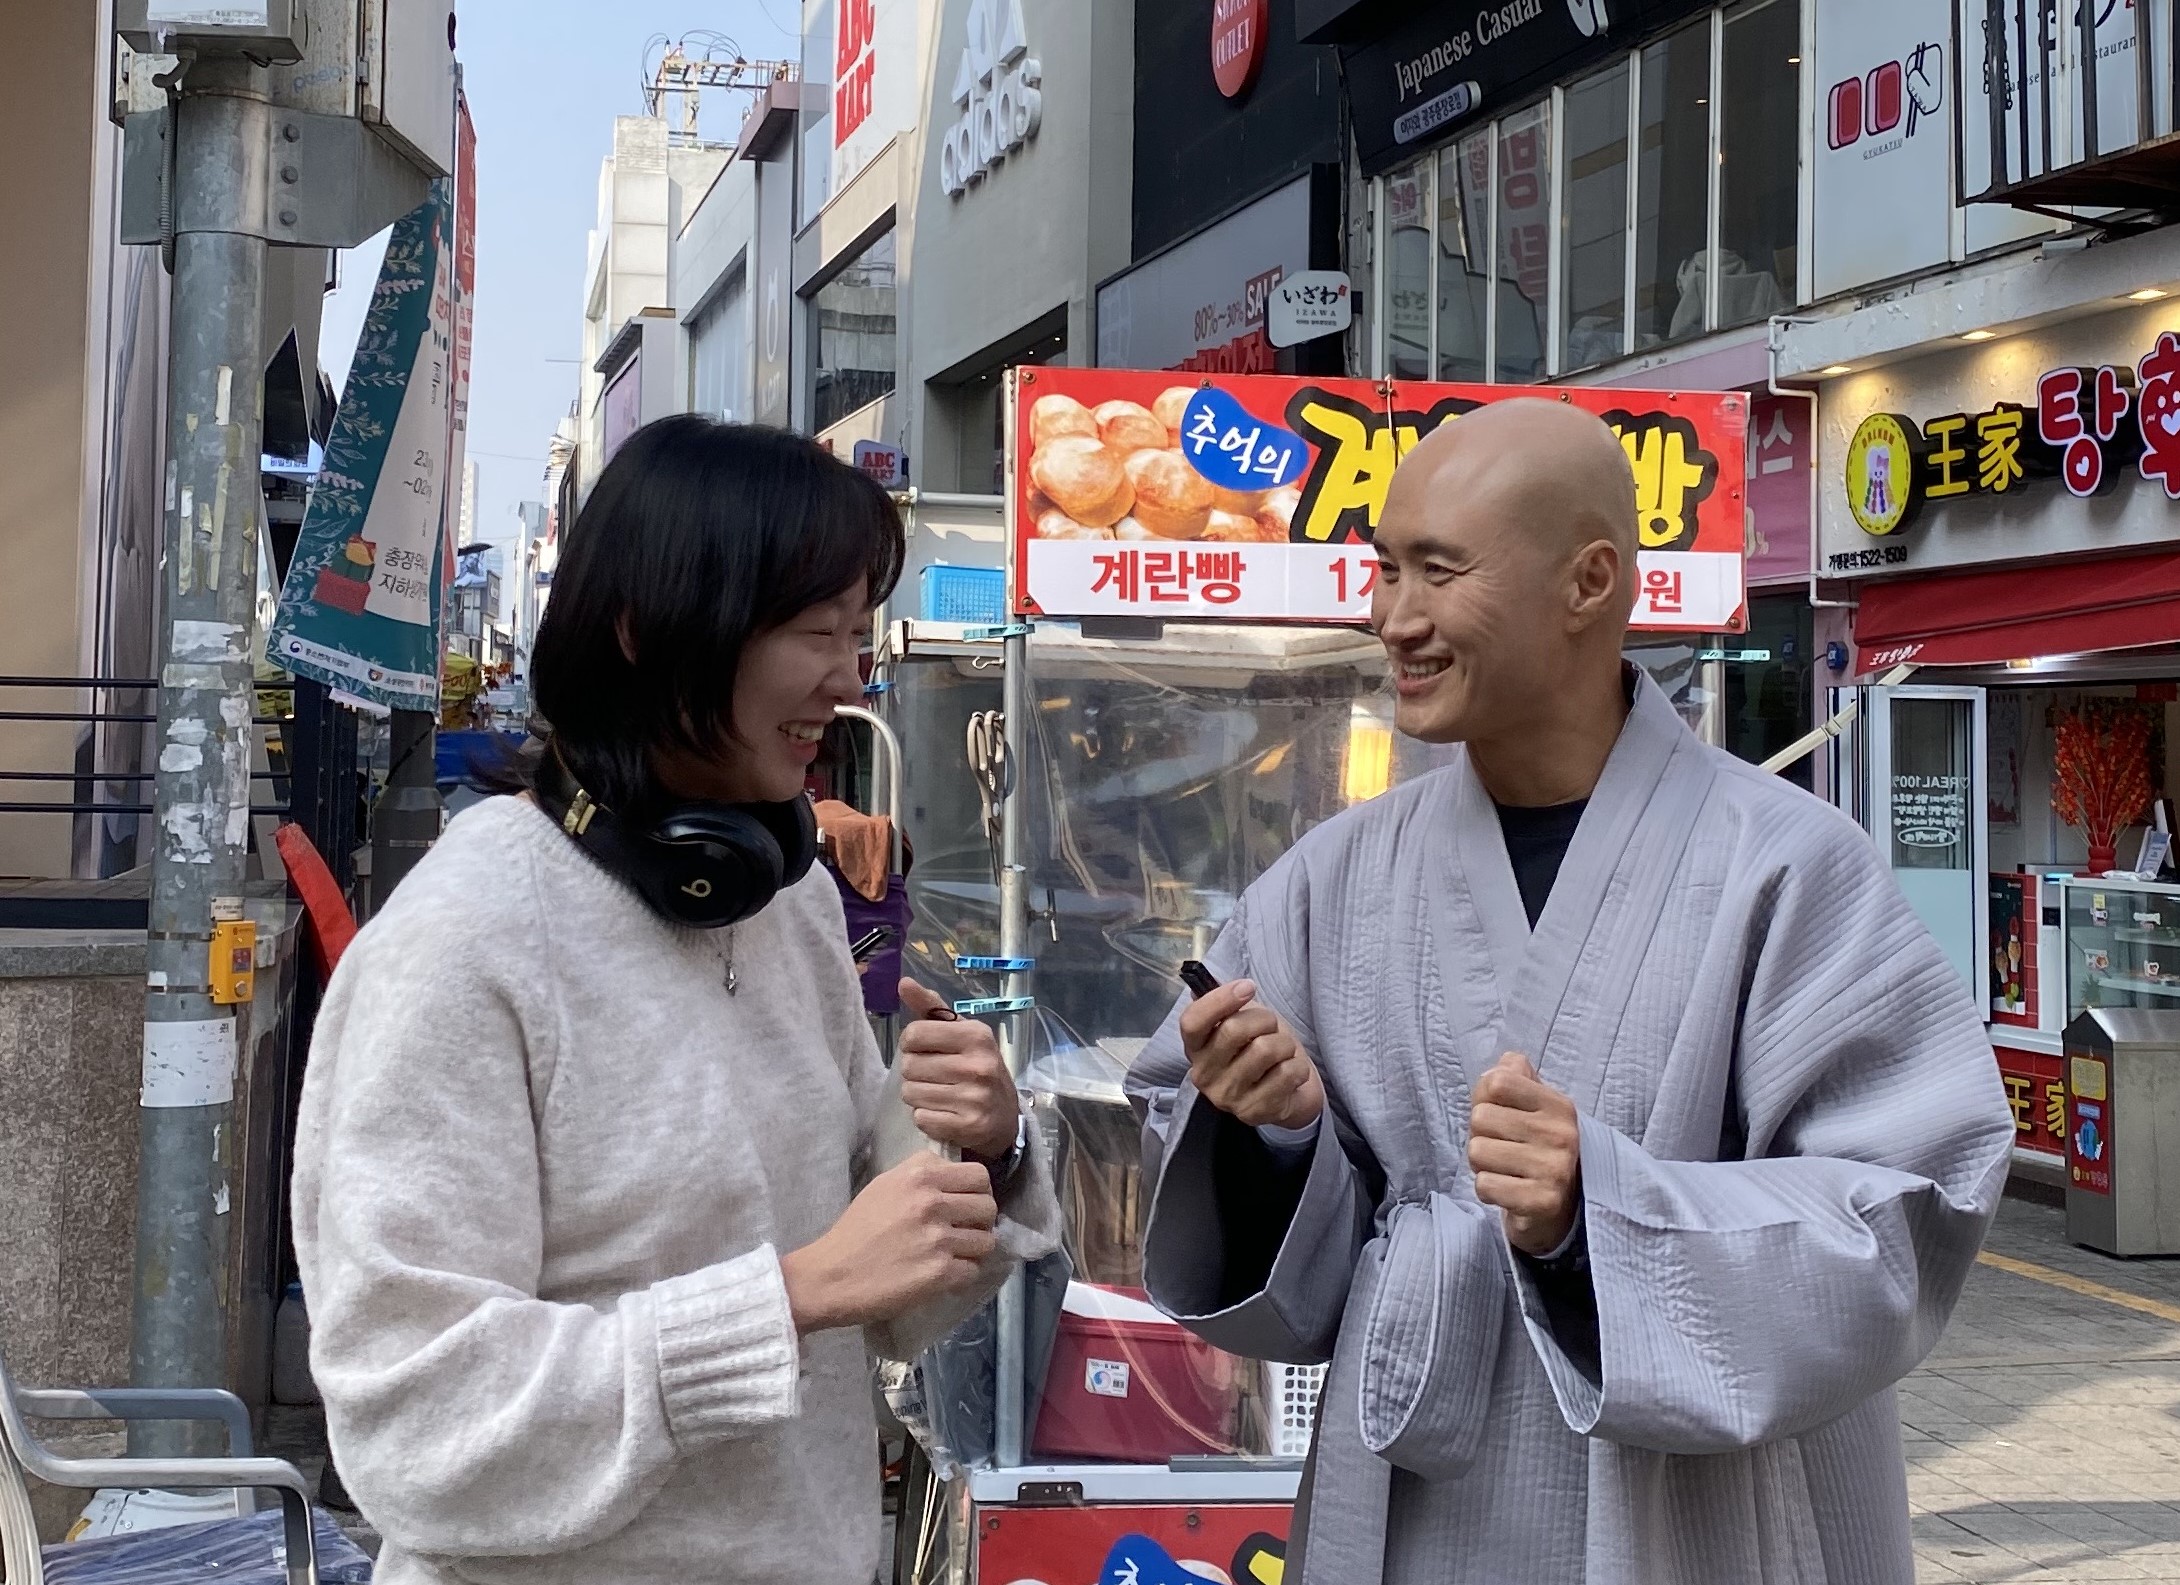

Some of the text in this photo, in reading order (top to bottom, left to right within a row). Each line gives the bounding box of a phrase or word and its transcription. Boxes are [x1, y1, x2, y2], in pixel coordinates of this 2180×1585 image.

[1216, 17, 1250, 68] OUTLET
[1395, 31, 1473, 103] Japanese
[1476, 0, 1544, 46] Casual
[835, 49, 875, 150] MART
[941, 58, 1042, 196] adidas
[1283, 285, 1339, 305] いざわ
[862, 451, 896, 468] ABC
[1186, 404, 1292, 484] 추억의
[1300, 401, 1705, 548] 계빵
[1926, 406, 2024, 498] 王家
[1090, 550, 1247, 604] 계란빵
